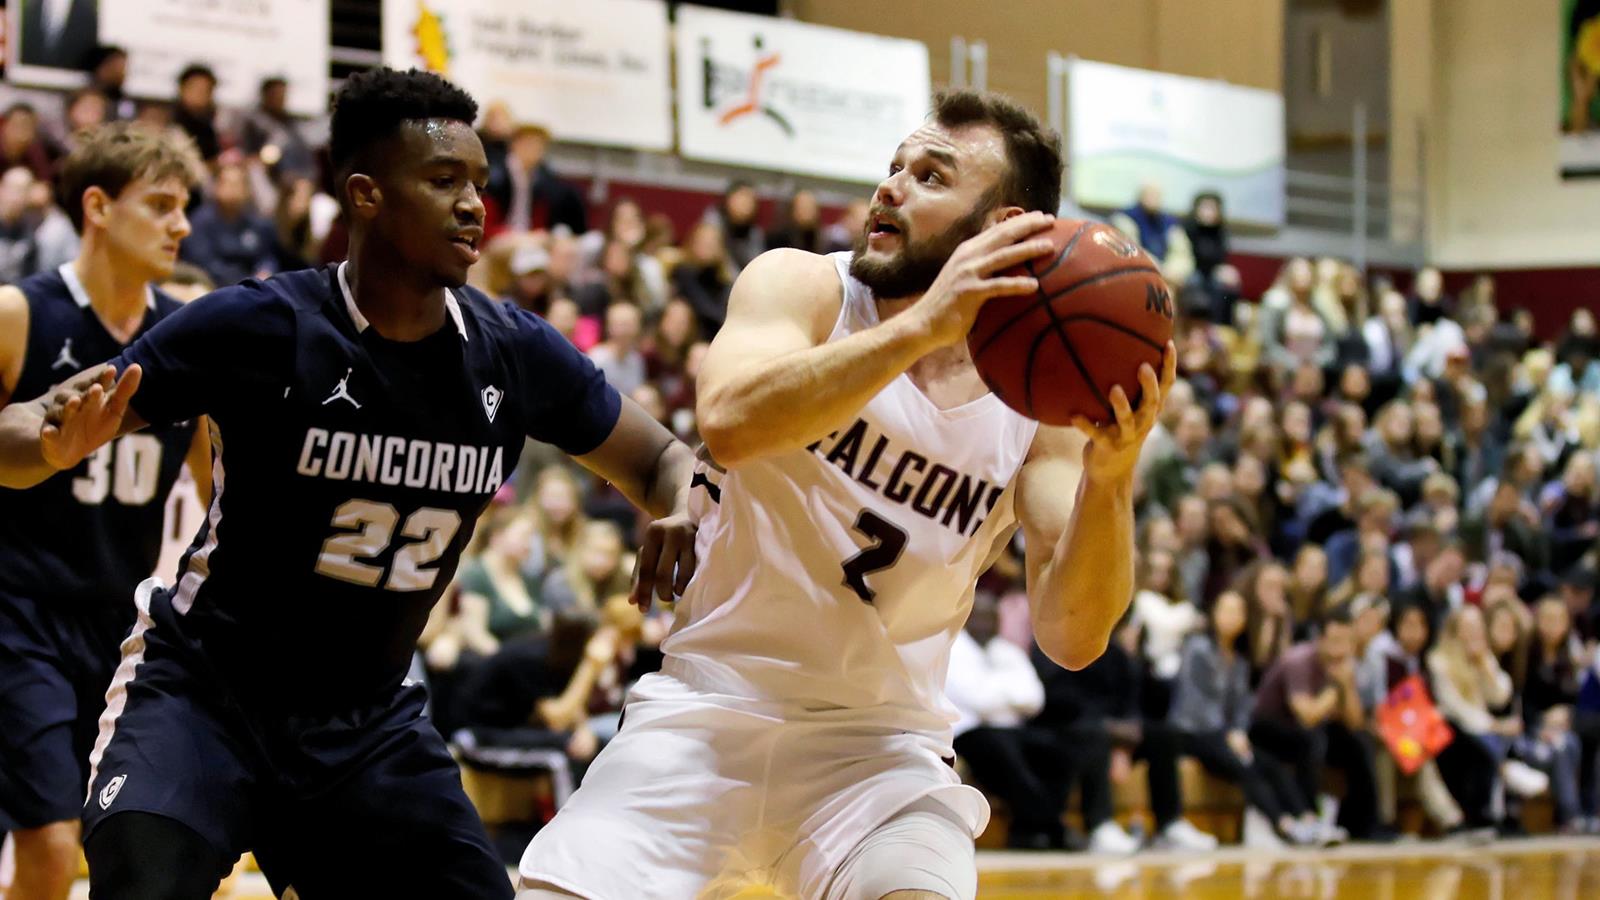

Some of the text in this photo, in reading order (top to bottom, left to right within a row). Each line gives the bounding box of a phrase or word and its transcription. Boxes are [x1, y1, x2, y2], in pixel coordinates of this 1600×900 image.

[72, 433, 162, 506] 30
[297, 427, 503, 494] CONCORDIA
[805, 417, 1004, 537] ALCON
[314, 498, 462, 592] 22
[841, 506, 910, 605] 2
